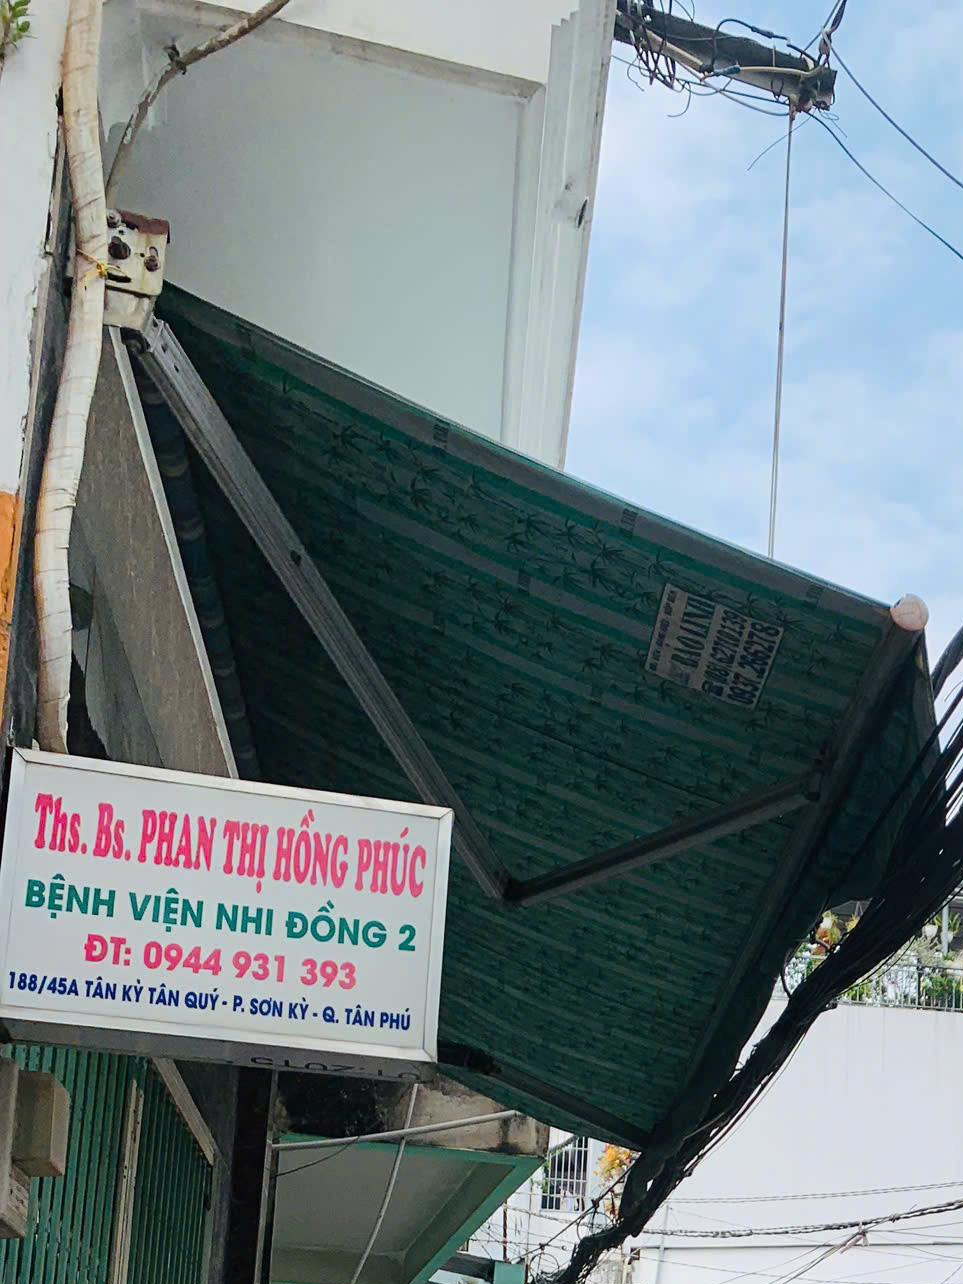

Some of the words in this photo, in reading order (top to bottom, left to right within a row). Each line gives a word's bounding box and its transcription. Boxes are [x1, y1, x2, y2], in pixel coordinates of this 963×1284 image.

[34, 793, 87, 854] Ths.
[93, 803, 131, 861] Bs.
[138, 809, 217, 871] PHAN
[223, 820, 269, 893] THỊ
[273, 809, 348, 888] HỒNG
[354, 826, 427, 898] PHÚC
[25, 873, 116, 919] BỆNH
[129, 888, 204, 932] VIỆN
[215, 903, 273, 936] NHI
[285, 900, 387, 948] ĐỒNG
[398, 924, 416, 951] 2
[84, 934, 131, 966] ĐT:
[143, 941, 222, 976] 0944
[232, 951, 285, 982] 931
[300, 958, 356, 990] 393
[9, 971, 79, 996] 188/45A
[85, 976, 117, 1000] TÂN
[122, 979, 143, 1003] KỲ
[148, 983, 179, 1006] TÂN
[184, 988, 219, 1010] QUÝ
[232, 995, 245, 1012] P.
[250, 998, 283, 1017] SƠN
[288, 998, 309, 1019] KỲ
[322, 1006, 339, 1024] Q.
[345, 1005, 375, 1027] TÂN
[380, 1008, 411, 1031] PHÚ
